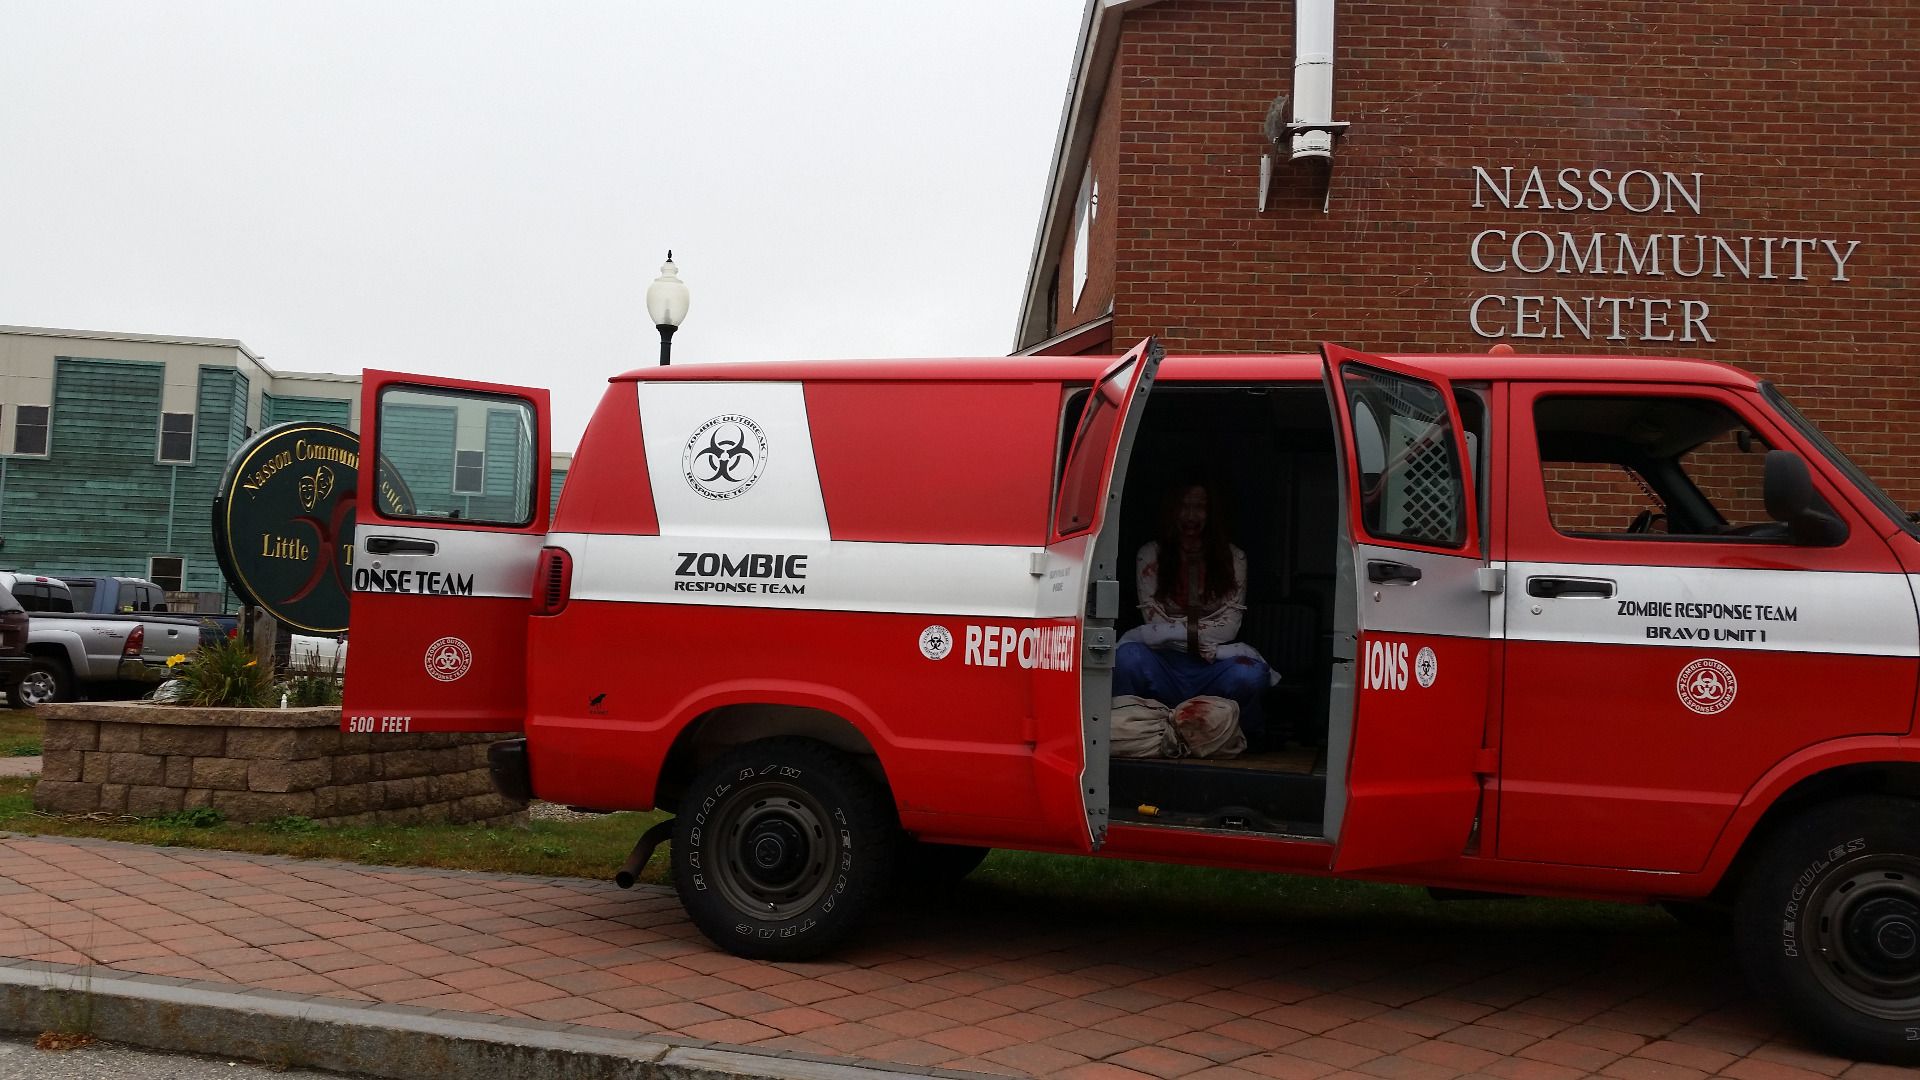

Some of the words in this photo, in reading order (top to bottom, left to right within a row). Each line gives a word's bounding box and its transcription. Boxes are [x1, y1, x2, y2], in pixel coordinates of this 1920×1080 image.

[1472, 166, 1704, 215] NASSON
[1470, 229, 1861, 281] COMMUNITY
[1470, 294, 1716, 343] CENTER
[687, 419, 720, 450] ZOMBIE
[722, 416, 767, 451] OUTBREAK
[243, 451, 292, 499] Nasson
[295, 438, 360, 470] Communi
[380, 469, 404, 513] ente
[686, 472, 731, 499] RESPONSE
[732, 474, 758, 496] TEAM
[261, 533, 309, 560] Little
[675, 552, 808, 579] ZOMBIE
[355, 568, 411, 592] ONSE
[416, 571, 474, 595] TEAM
[674, 581, 757, 593] RESPONSE
[760, 583, 805, 595] TEAM
[1618, 601, 1672, 617] ZOMBIE
[1675, 603, 1752, 620] RESPONSE
[1755, 605, 1797, 621] TEAM
[1646, 626, 1710, 641] BRAVO
[1714, 629, 1757, 642] UNIT
[1760, 630, 1766, 642] 1
[1363, 640, 1409, 691] IONS
[1681, 661, 1702, 683] ZOMBIE
[1703, 661, 1734, 684] OUTBREAK
[1681, 692, 1715, 712] RESPONSE
[1715, 694, 1732, 709] TEAM
[349, 716, 375, 733] 500
[381, 716, 412, 733] FEET
[690, 784, 731, 890] RADIAL
[822, 808, 852, 912] TERRA
[1783, 838, 1866, 957] HERCULES
